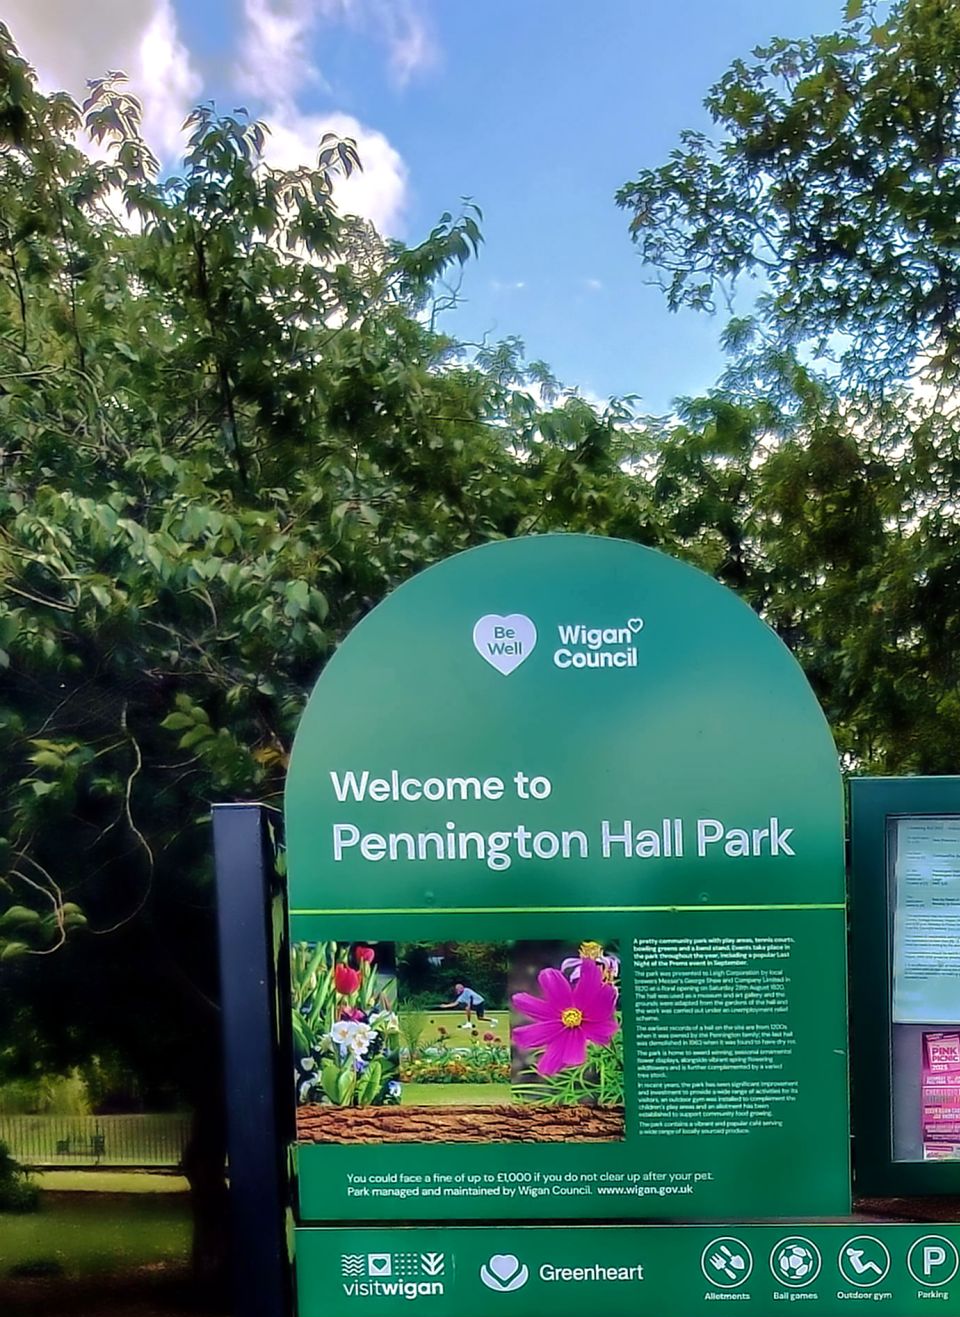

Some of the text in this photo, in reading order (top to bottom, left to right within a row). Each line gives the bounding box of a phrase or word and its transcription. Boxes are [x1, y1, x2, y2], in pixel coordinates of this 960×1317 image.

[494, 626, 516, 639] Be
[558, 625, 632, 650] Wigan
[488, 641, 522, 656] Well
[554, 648, 637, 668] Council
[330, 769, 552, 802] Welcome to
[332, 817, 796, 871] Pennington Hall Park
[931, 1046, 958, 1055] PINK
[932, 1054, 960, 1062] PICNIC
[346, 1173, 367, 1183] You
[369, 1172, 398, 1183] could
[400, 1173, 422, 1183] face
[424, 1175, 431, 1183] a
[433, 1172, 453, 1183] fine
[454, 1172, 465, 1183] of
[467, 1174, 482, 1185] up
[484, 1174, 495, 1183] to
[533, 1172, 541, 1182] if
[542, 1174, 562, 1185] you
[564, 1172, 579, 1182] do
[580, 1173, 598, 1182] not
[599, 1171, 625, 1182] clear
[627, 1173, 641, 1184] up
[642, 1171, 669, 1181] after
[669, 1173, 693, 1183] your
[694, 1172, 714, 1183] pet.
[347, 1183, 694, 1199] Park managed and maintained by Wigan Council. www.wigan.gov.uk
[924, 1246, 946, 1275] P
[539, 1264, 644, 1282] Greenheart
[343, 1280, 445, 1300] visitwigan
[704, 1291, 751, 1300] Allotments
[773, 1291, 818, 1301] Ball games
[837, 1291, 892, 1301] Outdoor gym
[917, 1290, 949, 1300] Parking
